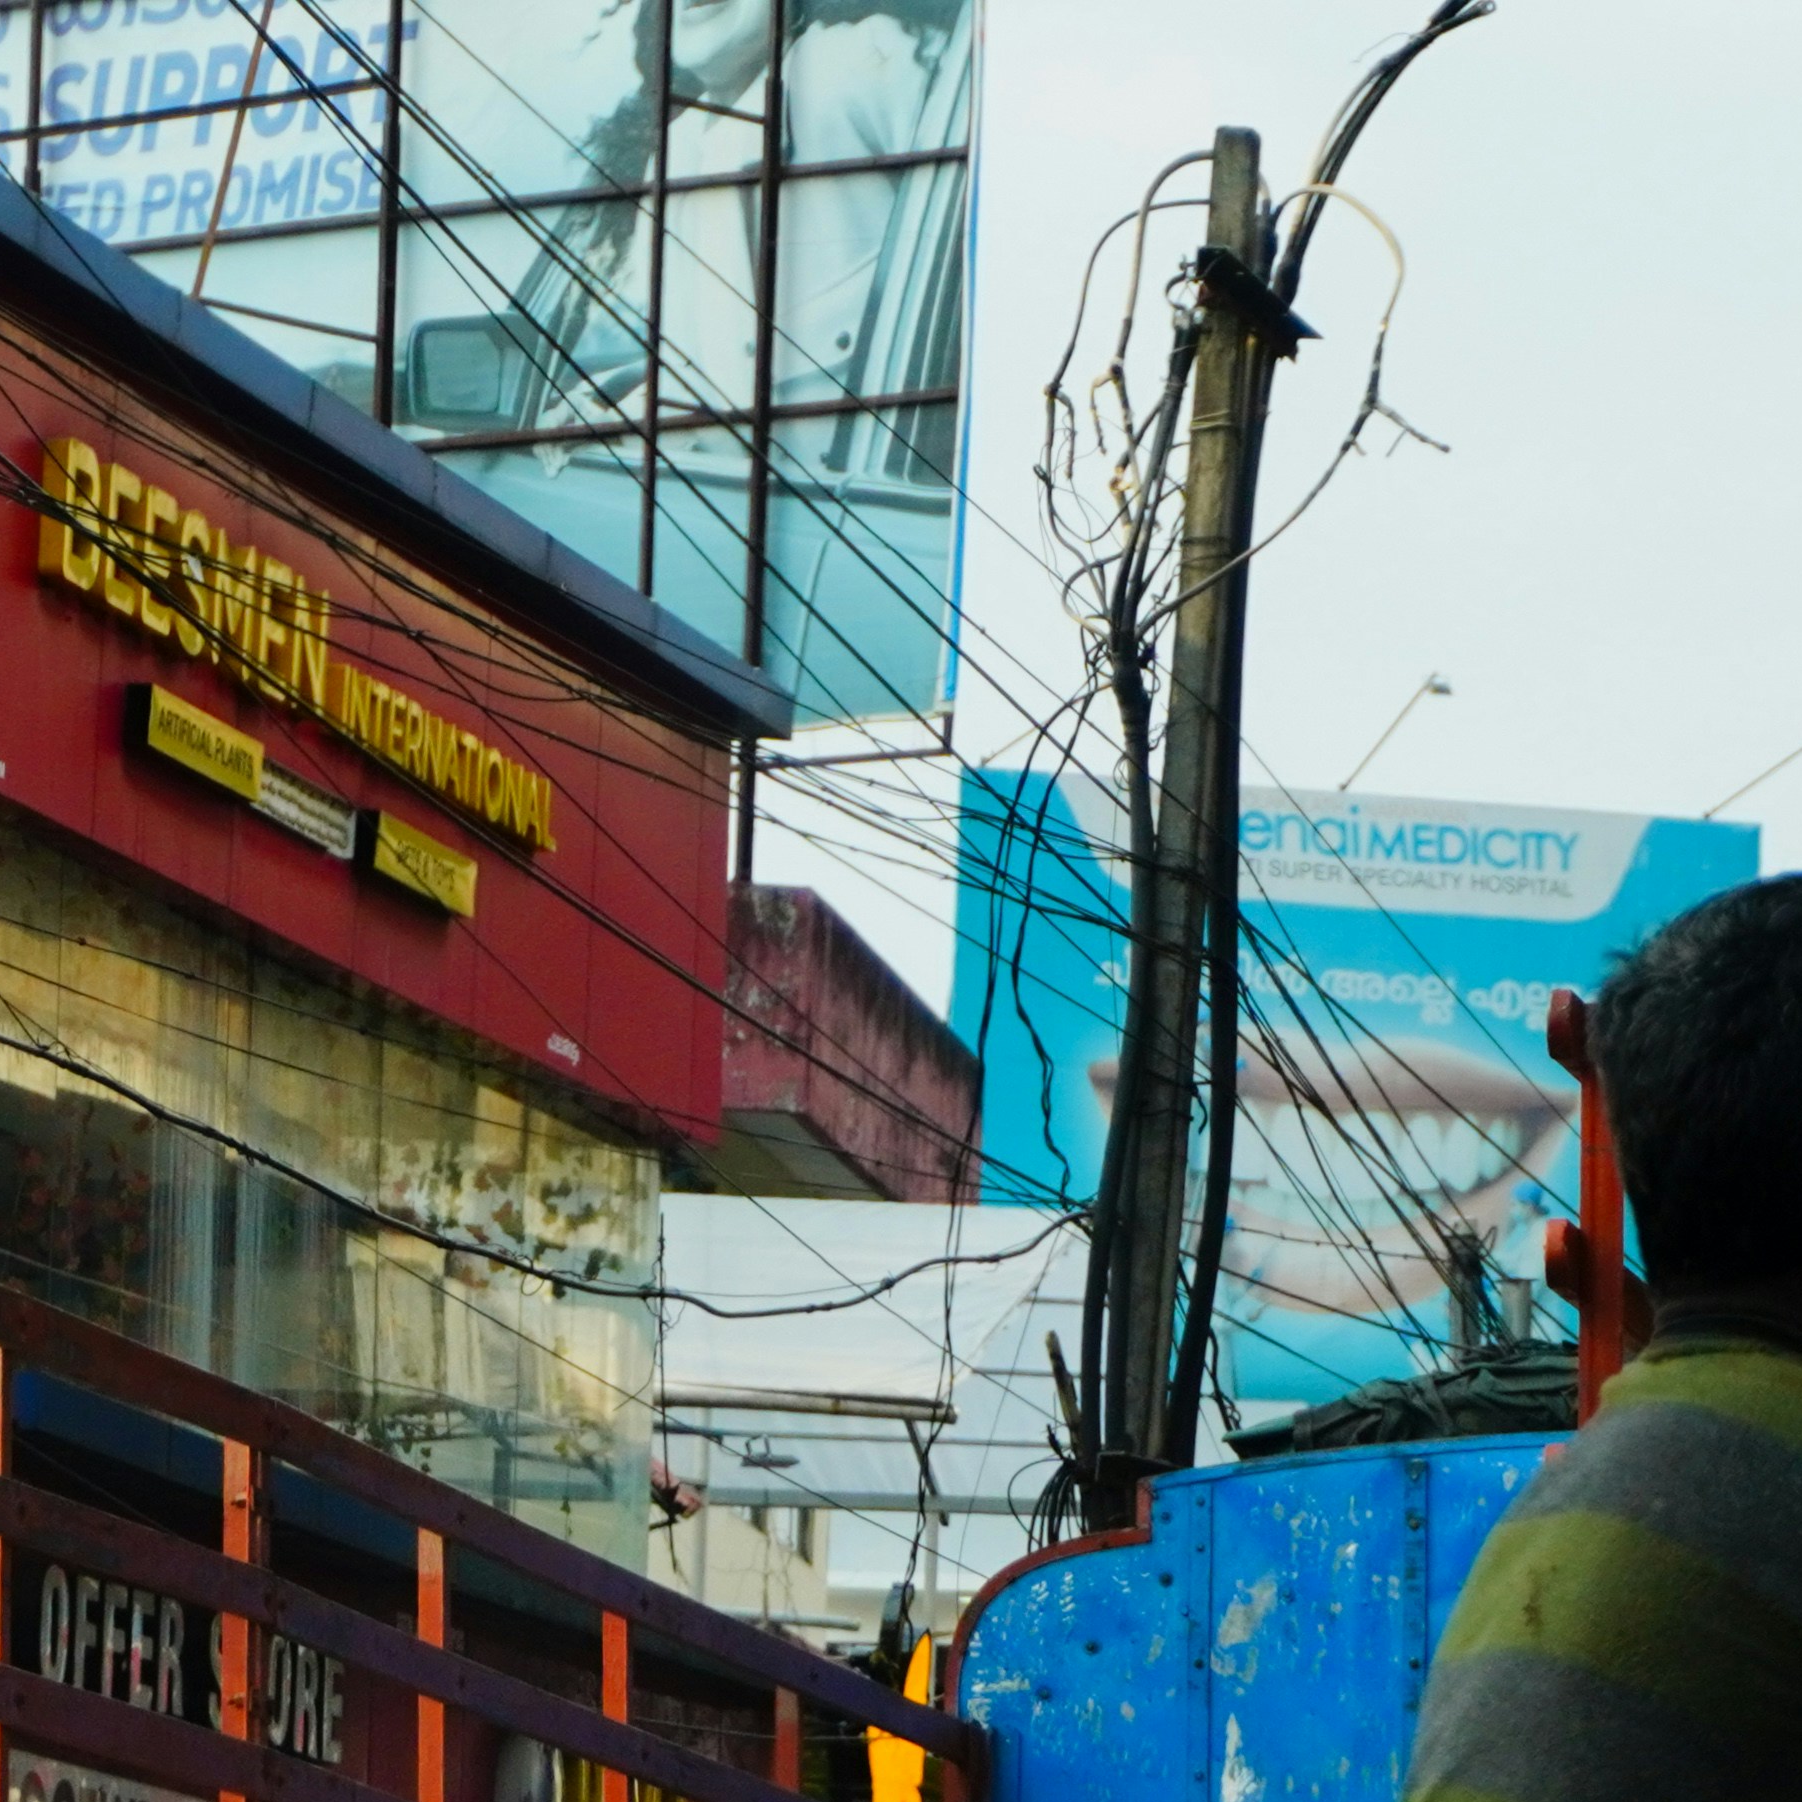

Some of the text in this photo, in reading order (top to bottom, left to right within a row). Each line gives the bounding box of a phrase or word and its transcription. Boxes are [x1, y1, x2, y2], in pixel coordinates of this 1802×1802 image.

[40, 19, 419, 163] SUPPORT
[56, 437, 557, 852] BEESMEN INTERNATIONAL
[158, 705, 254, 782] ARTIFICIAL PLANTS
[1268, 857, 1342, 884] SUPER
[1351, 866, 1464, 893] SPECIALTY
[1470, 873, 1574, 899] HOSPITAL
[1367, 824, 1580, 872] MEDICITY
[39, 1563, 185, 1718] OFFER
